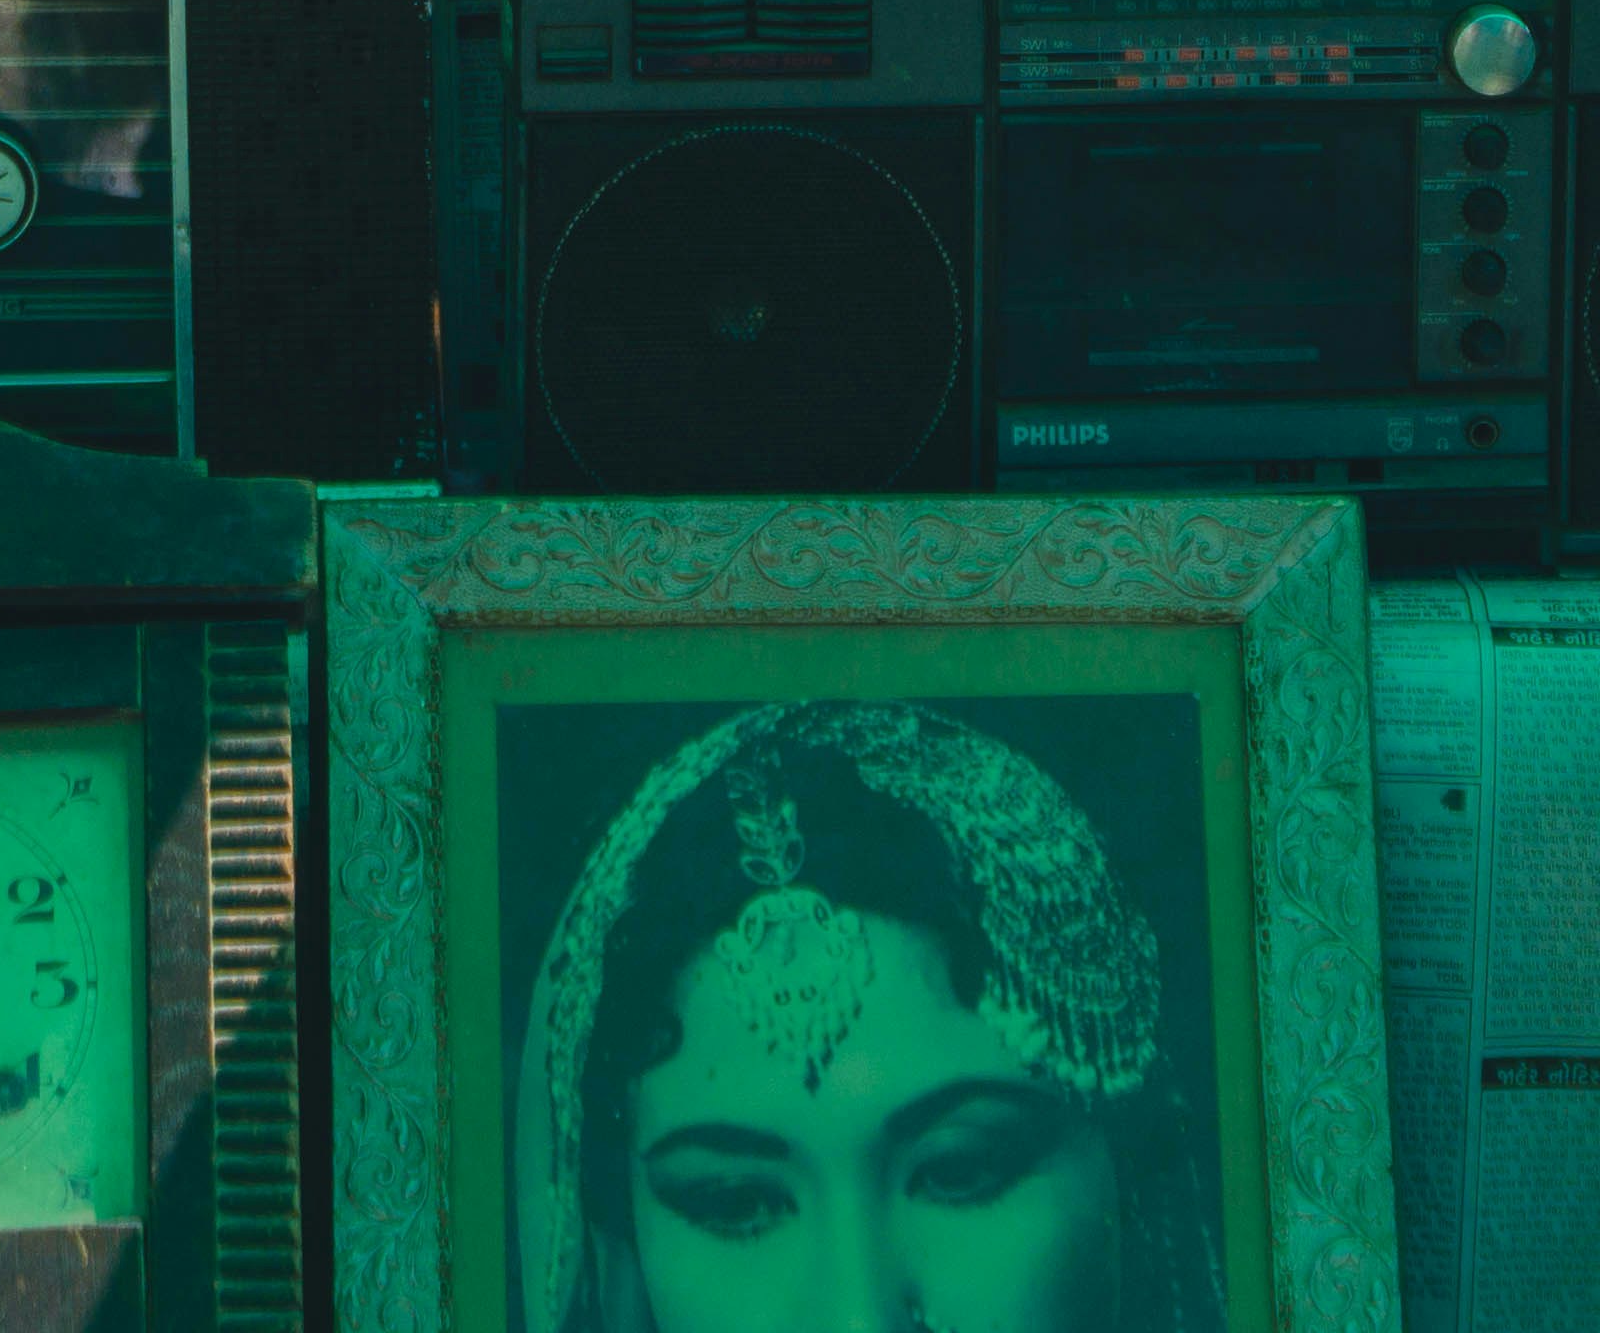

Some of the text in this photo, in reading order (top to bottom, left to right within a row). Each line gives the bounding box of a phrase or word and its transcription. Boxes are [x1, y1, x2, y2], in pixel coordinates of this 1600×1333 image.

[1012, 423, 1111, 447] PHILIPS
[5, 873, 56, 926] 2
[28, 958, 80, 1010] 3
